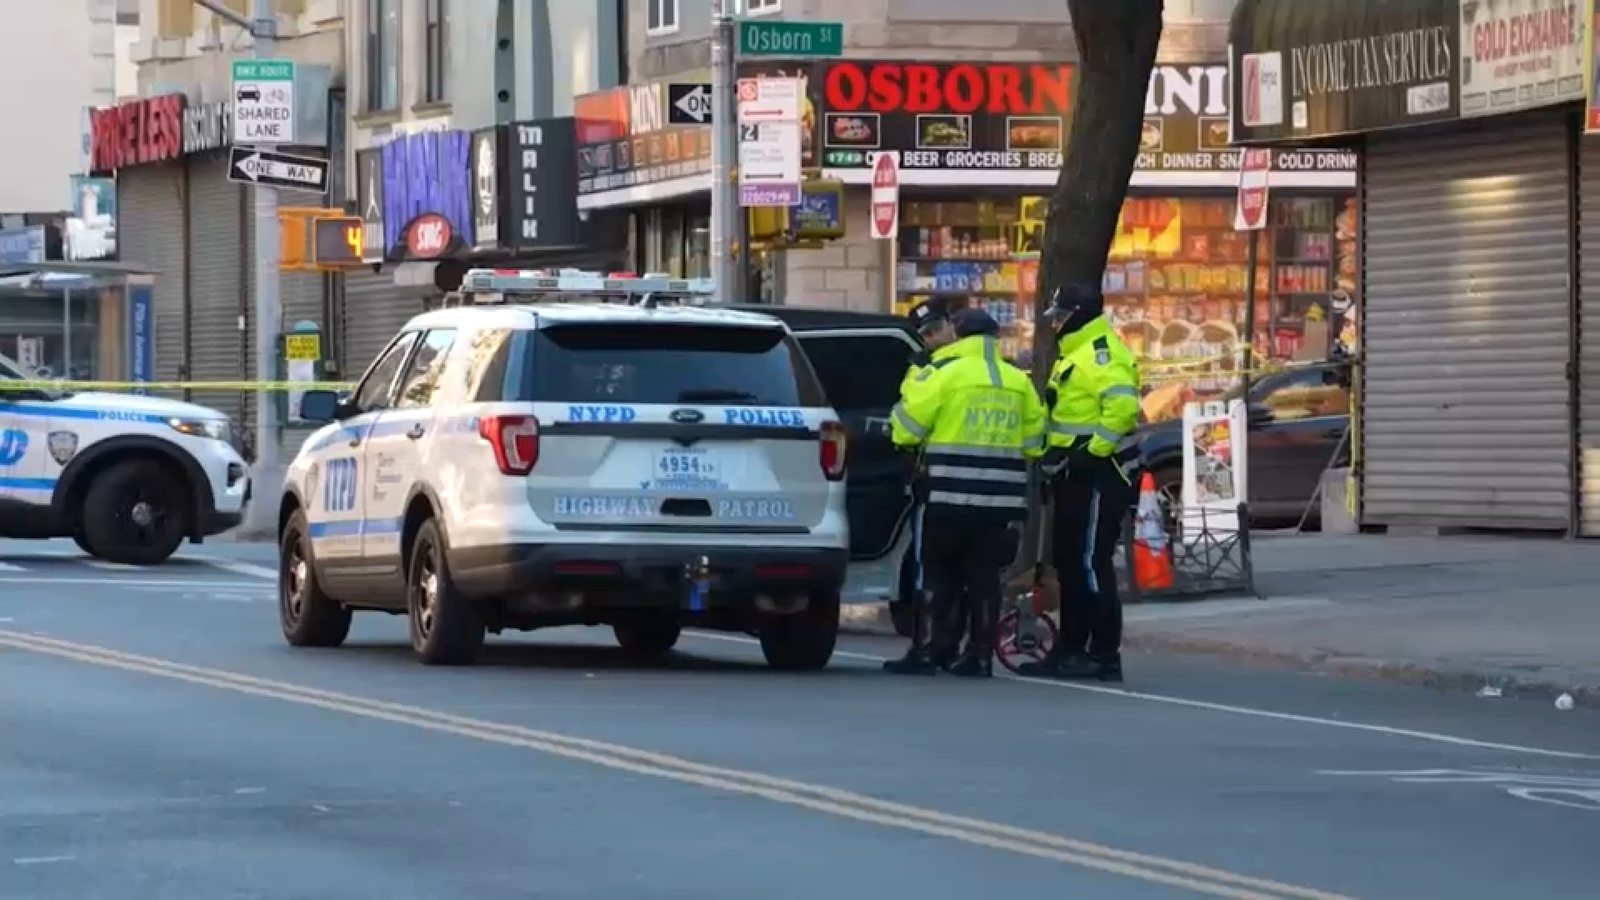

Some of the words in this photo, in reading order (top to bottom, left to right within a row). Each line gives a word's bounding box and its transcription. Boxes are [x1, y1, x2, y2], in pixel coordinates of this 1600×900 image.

[747, 25, 811, 51] Osborn
[1474, 18, 1506, 63] GOLD
[1510, 3, 1576, 57] EXCHANGE
[1291, 40, 1350, 97] INCOME
[1350, 35, 1382, 90] TAX
[1383, 26, 1451, 85] SERVICES
[825, 63, 1075, 114] OSBORN
[237, 107, 290, 121] SHARED
[246, 124, 281, 137] LANE
[246, 160, 274, 176] ONE
[287, 165, 316, 180] WAY
[904, 151, 939, 167] BEER
[946, 151, 1021, 167] GROCERIES
[1163, 152, 1212, 168] DINNER
[1278, 153, 1314, 169] COLD
[346, 226, 362, 256] 4
[568, 405, 636, 423] NYPD
[724, 408, 805, 426] POLICE
[964, 406, 1019, 431] NYPD
[658, 456, 700, 473] 4954
[553, 496, 656, 517] HIGHWAY
[719, 500, 795, 518] PATROL
